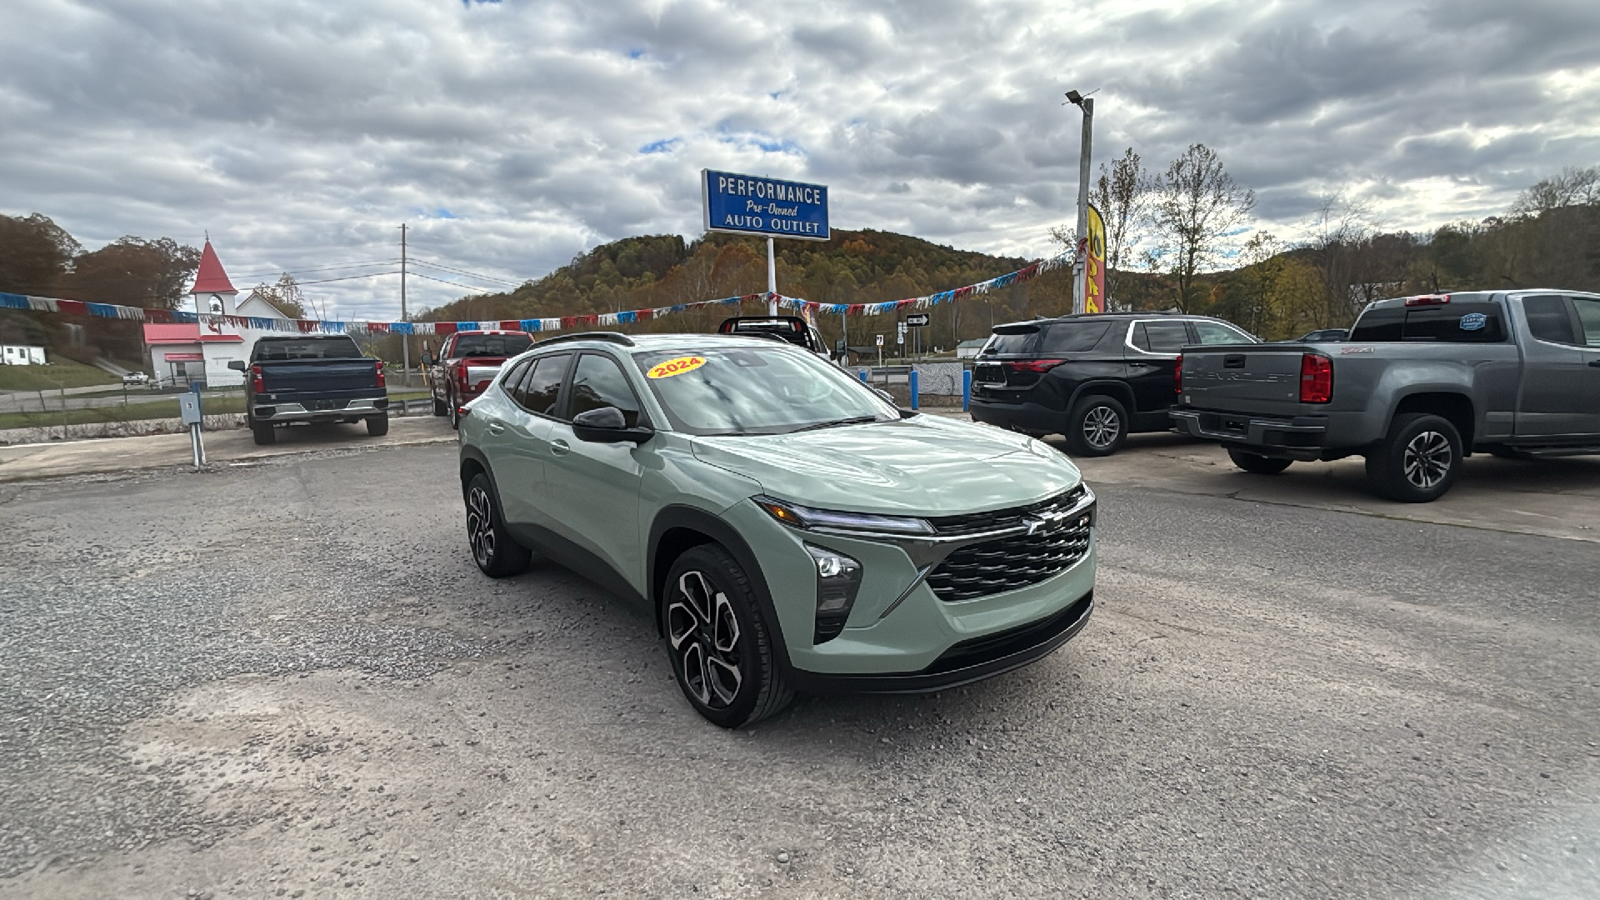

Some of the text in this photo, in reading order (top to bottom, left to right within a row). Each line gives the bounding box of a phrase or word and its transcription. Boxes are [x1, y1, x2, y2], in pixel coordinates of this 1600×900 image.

[719, 176, 821, 205] PERFORMANCE
[746, 200, 798, 217] Pre-Owned
[724, 214, 819, 234] AUTO OUTLET
[655, 358, 701, 376] 2024
